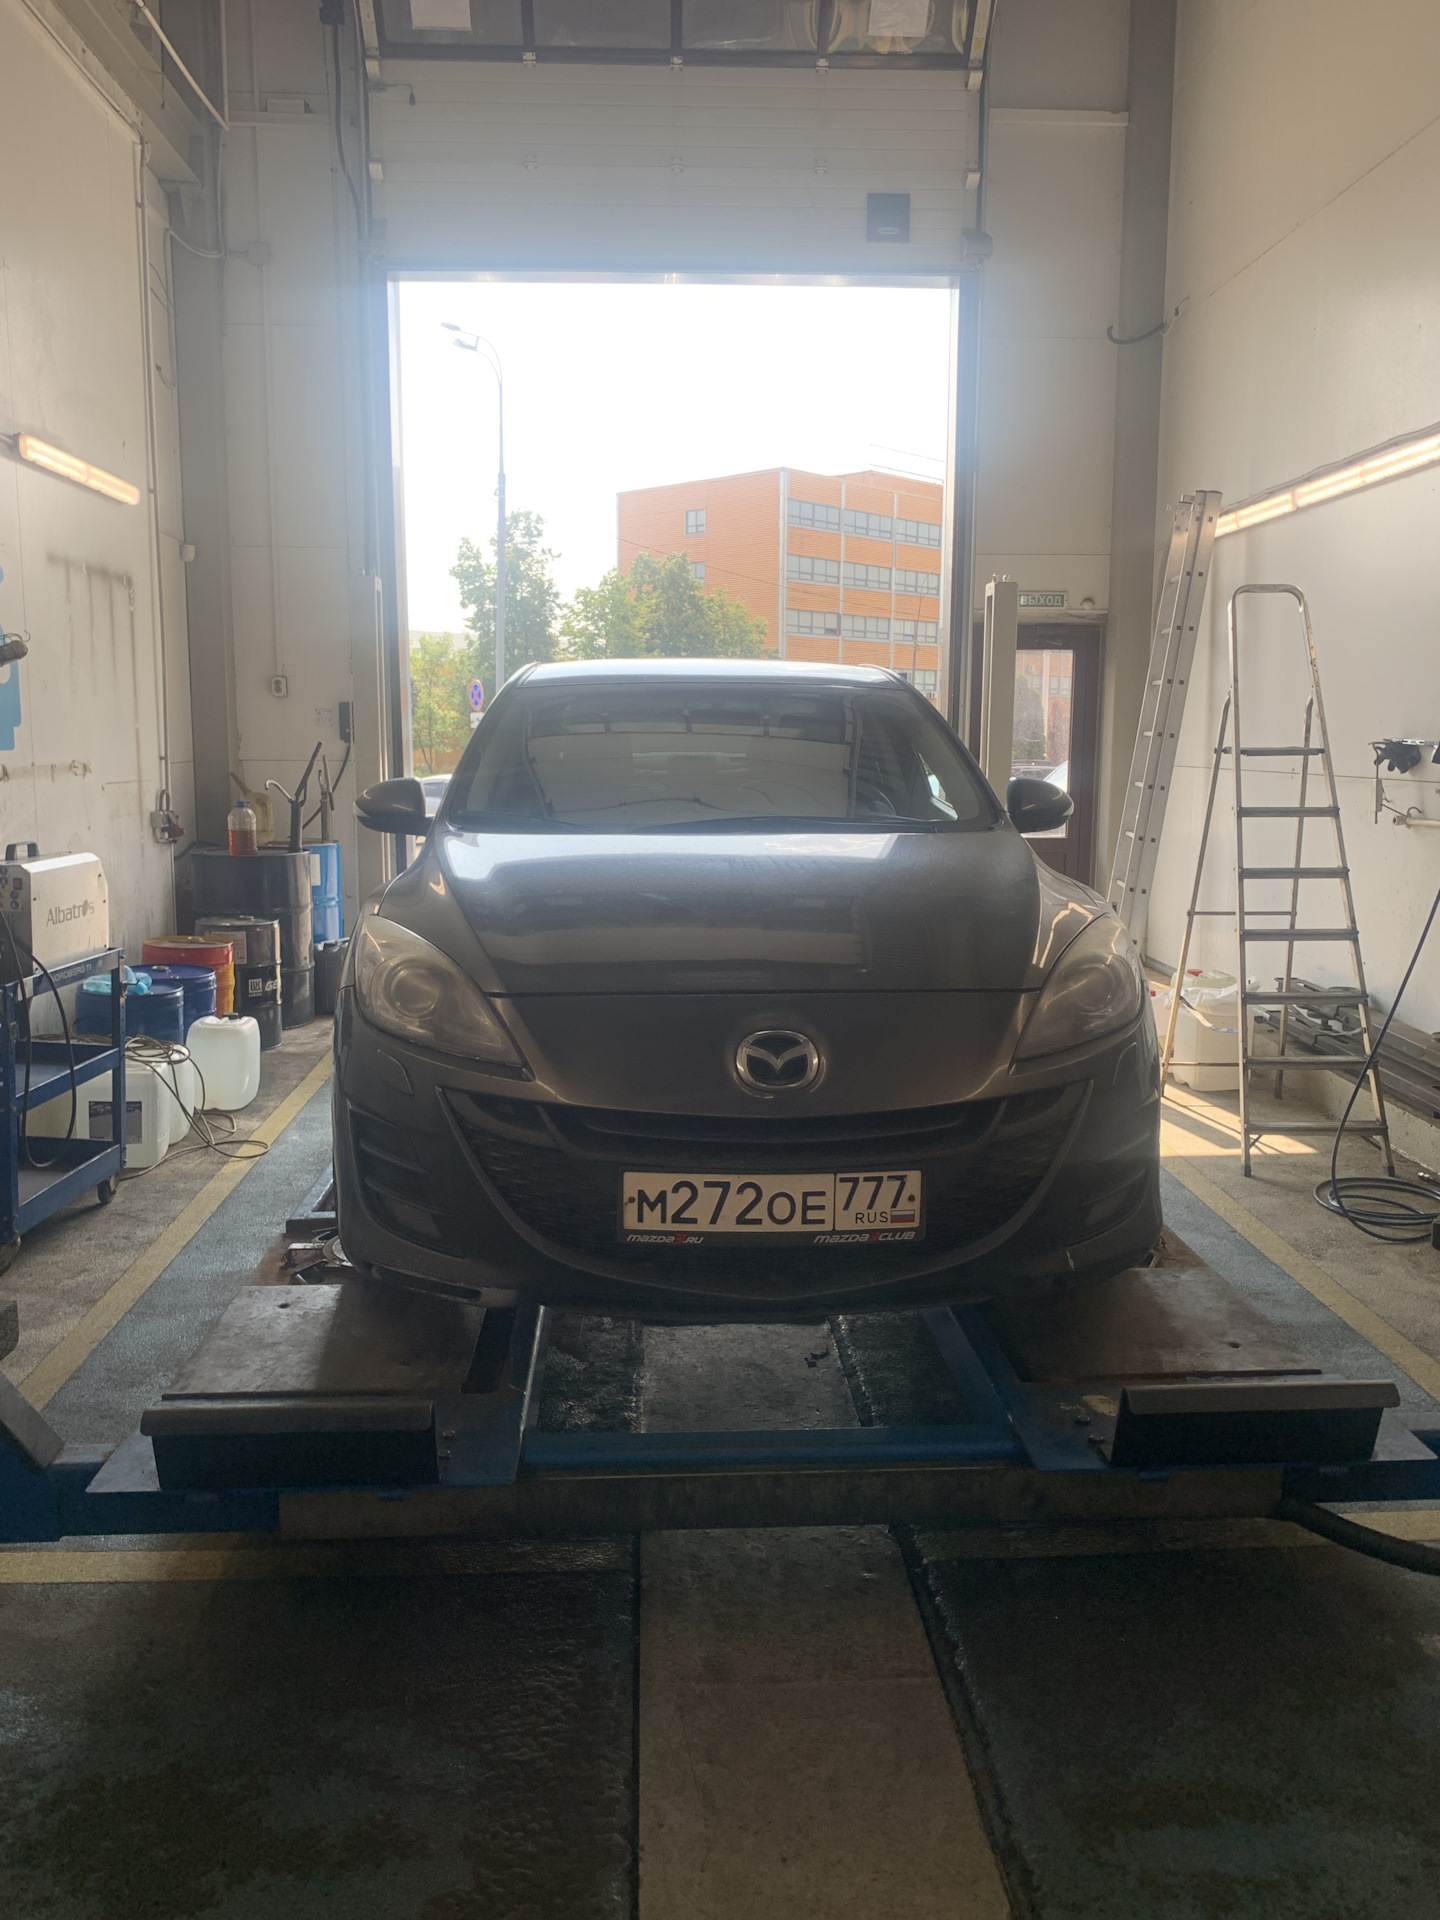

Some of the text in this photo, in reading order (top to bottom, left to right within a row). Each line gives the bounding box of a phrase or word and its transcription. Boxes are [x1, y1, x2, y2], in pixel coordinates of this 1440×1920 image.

[1020, 595, 1061, 606] ВЫХОД
[46, 900, 95, 927] Albatros
[838, 1174, 908, 1210] 777
[855, 1211, 889, 1224] RUS
